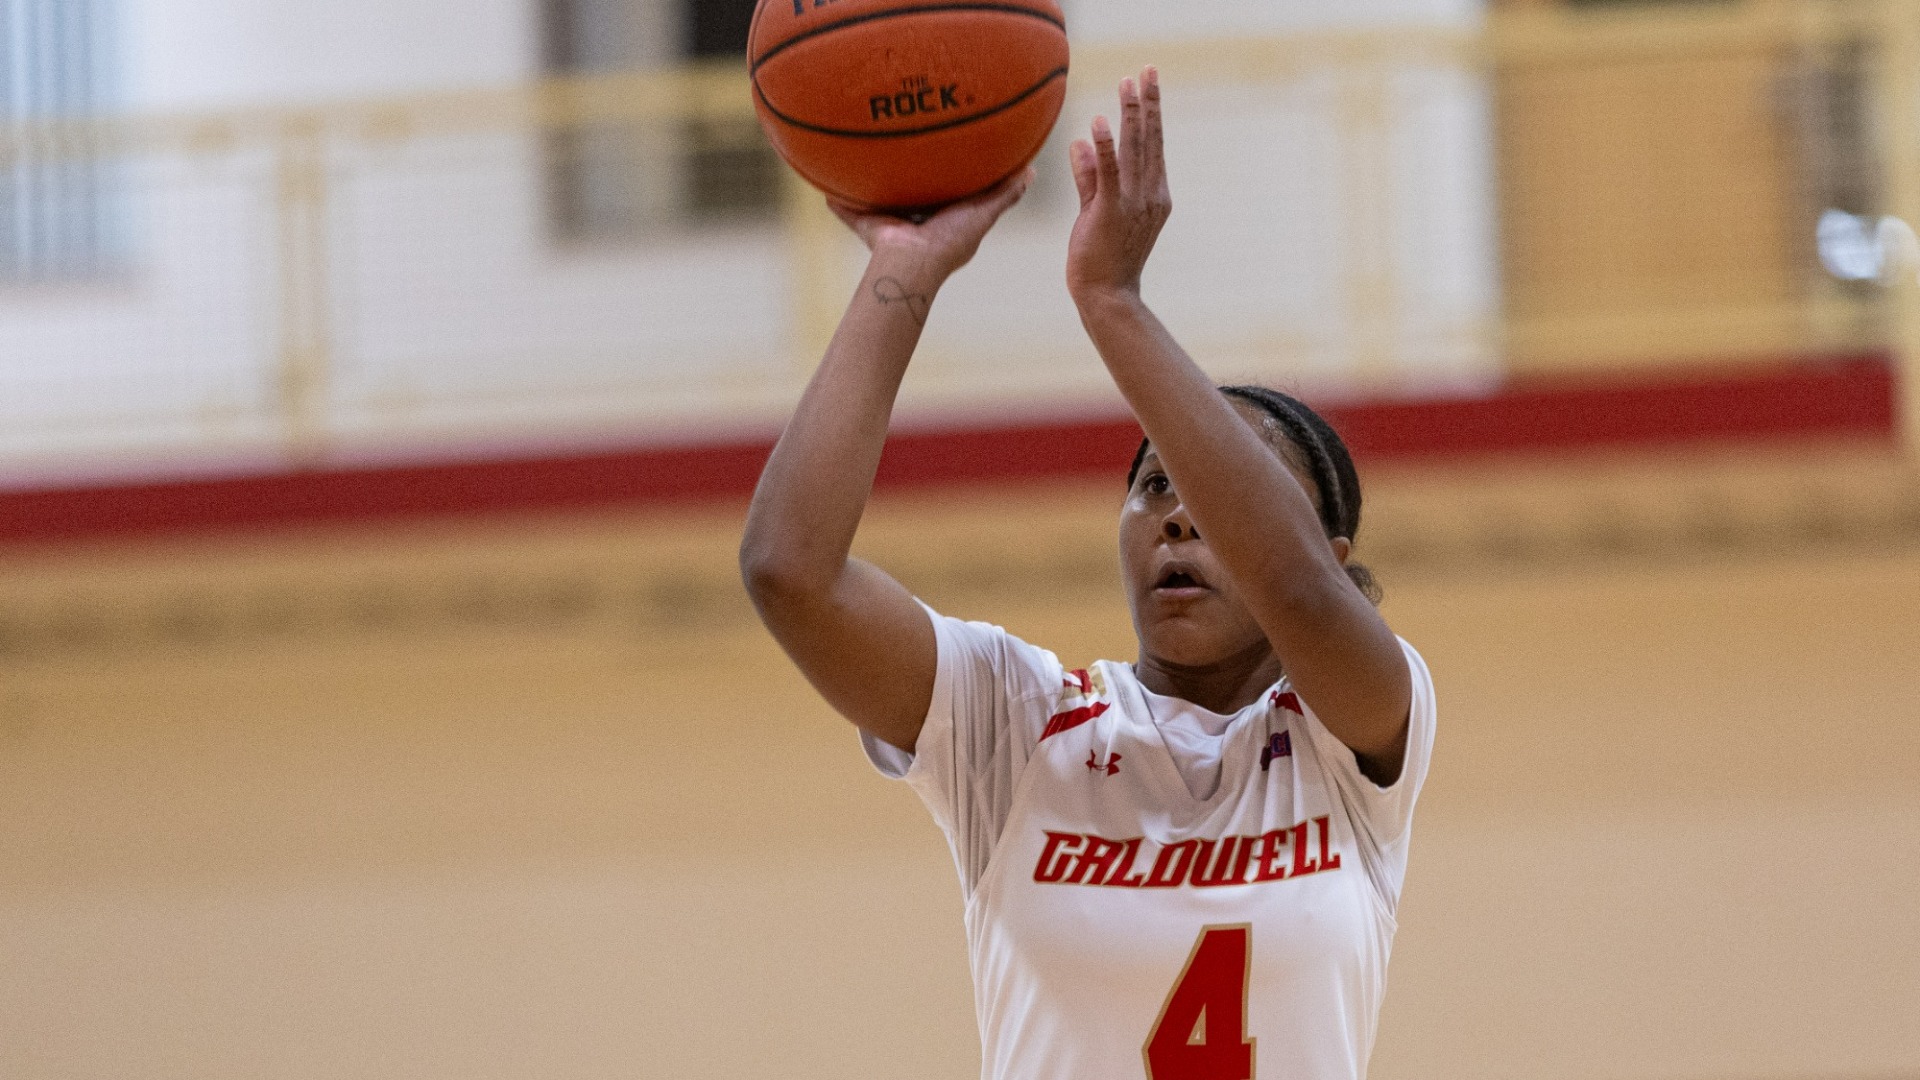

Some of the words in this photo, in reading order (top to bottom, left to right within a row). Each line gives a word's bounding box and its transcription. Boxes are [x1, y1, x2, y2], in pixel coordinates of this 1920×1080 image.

[869, 83, 959, 121] ROCK
[901, 76, 929, 90] THE
[1032, 814, 1342, 889] CALDWELL
[1141, 922, 1258, 1080] 4
